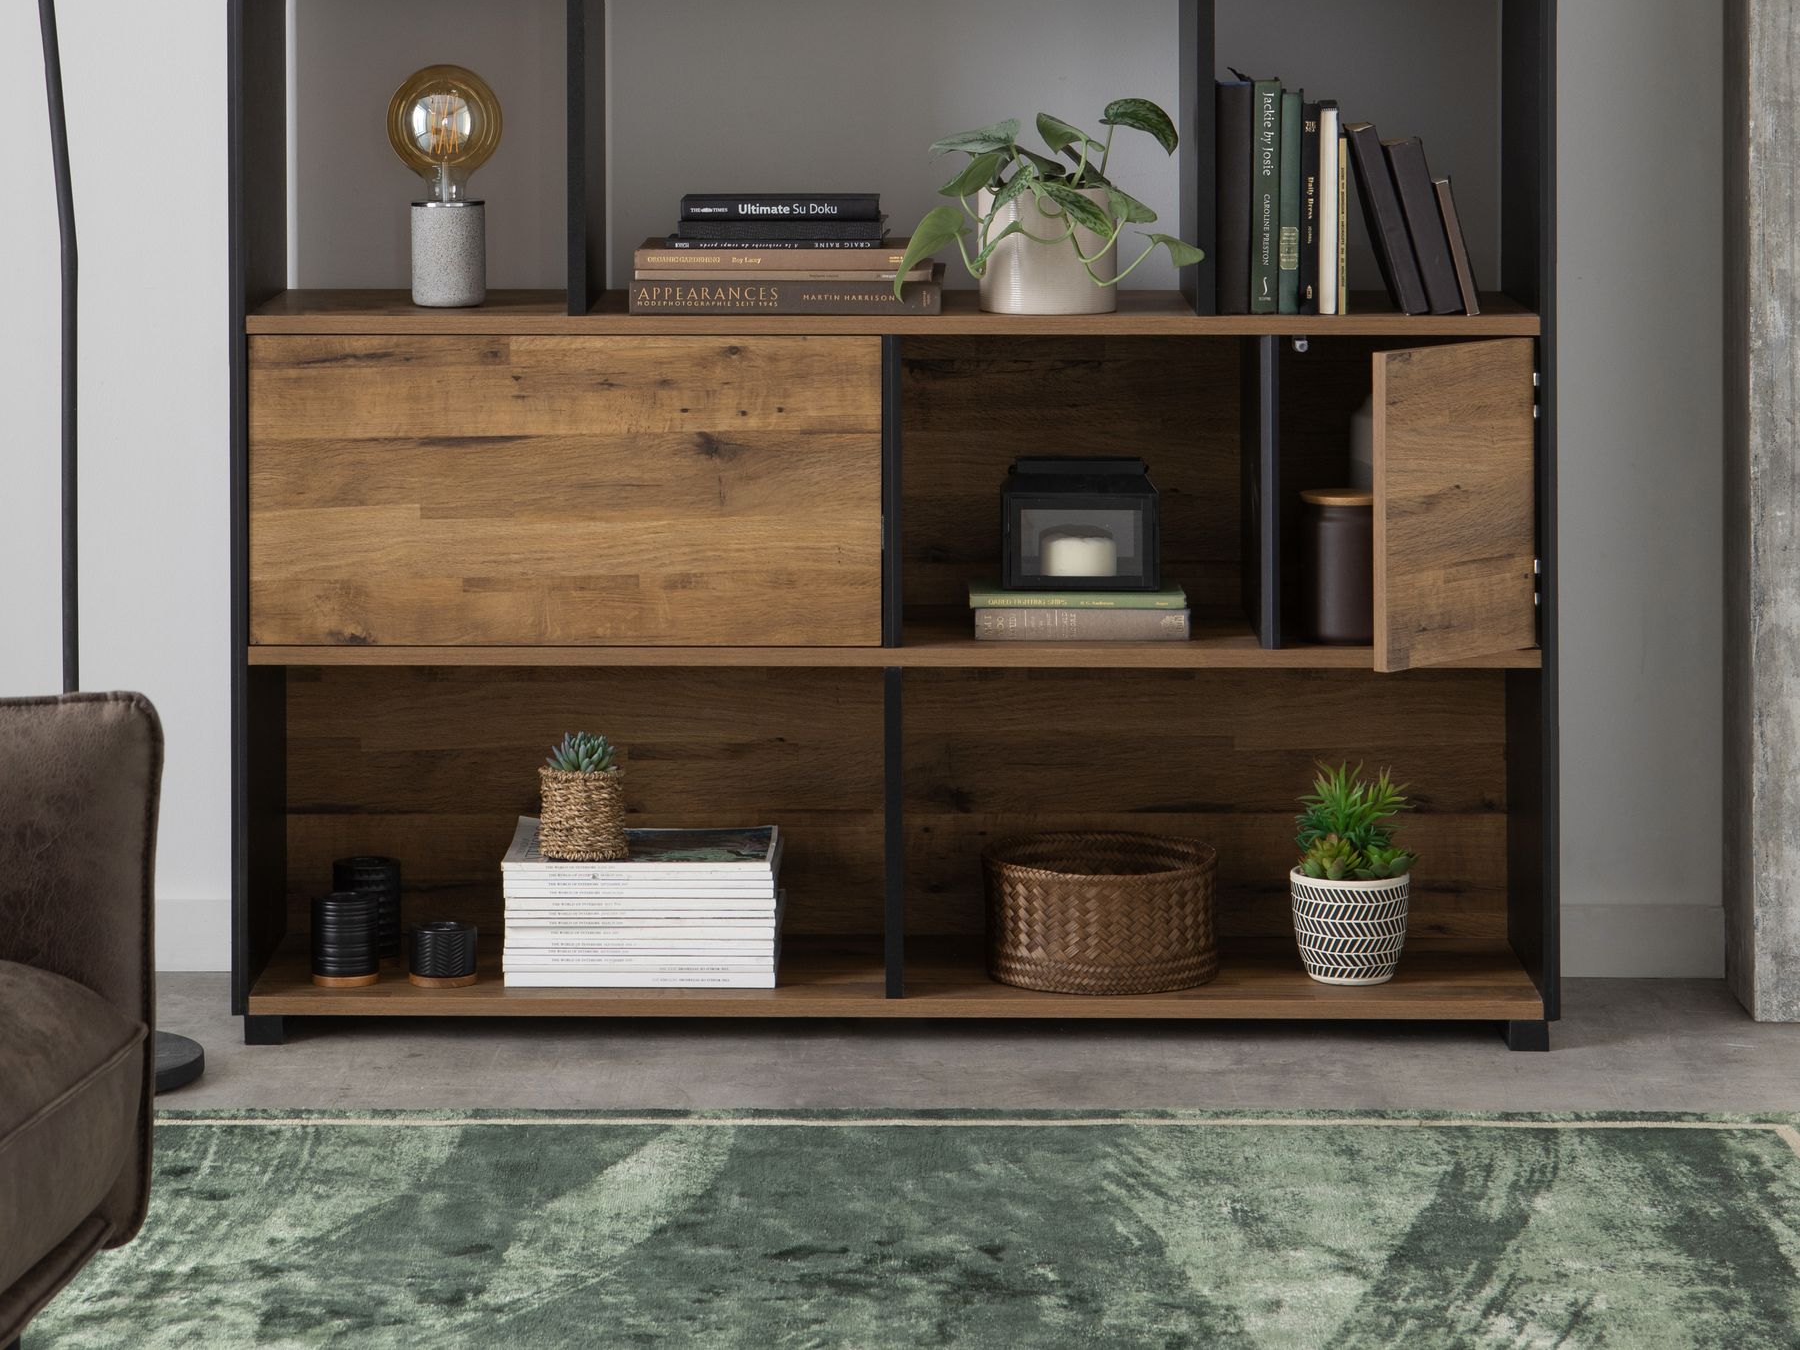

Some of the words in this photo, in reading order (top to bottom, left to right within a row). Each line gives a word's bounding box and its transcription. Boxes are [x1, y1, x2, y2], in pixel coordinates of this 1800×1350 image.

[1263, 92, 1275, 128] Jackie
[1262, 131, 1273, 144] by
[1262, 147, 1273, 176] Josie
[738, 203, 790, 215] Ultimate
[792, 203, 806, 215] Su
[809, 203, 838, 215] Doku
[1263, 194, 1271, 231] CAROLINE
[1262, 233, 1270, 266] PRESTON
[638, 287, 778, 300] APPEARANCES
[844, 294, 895, 302] HARRISON
